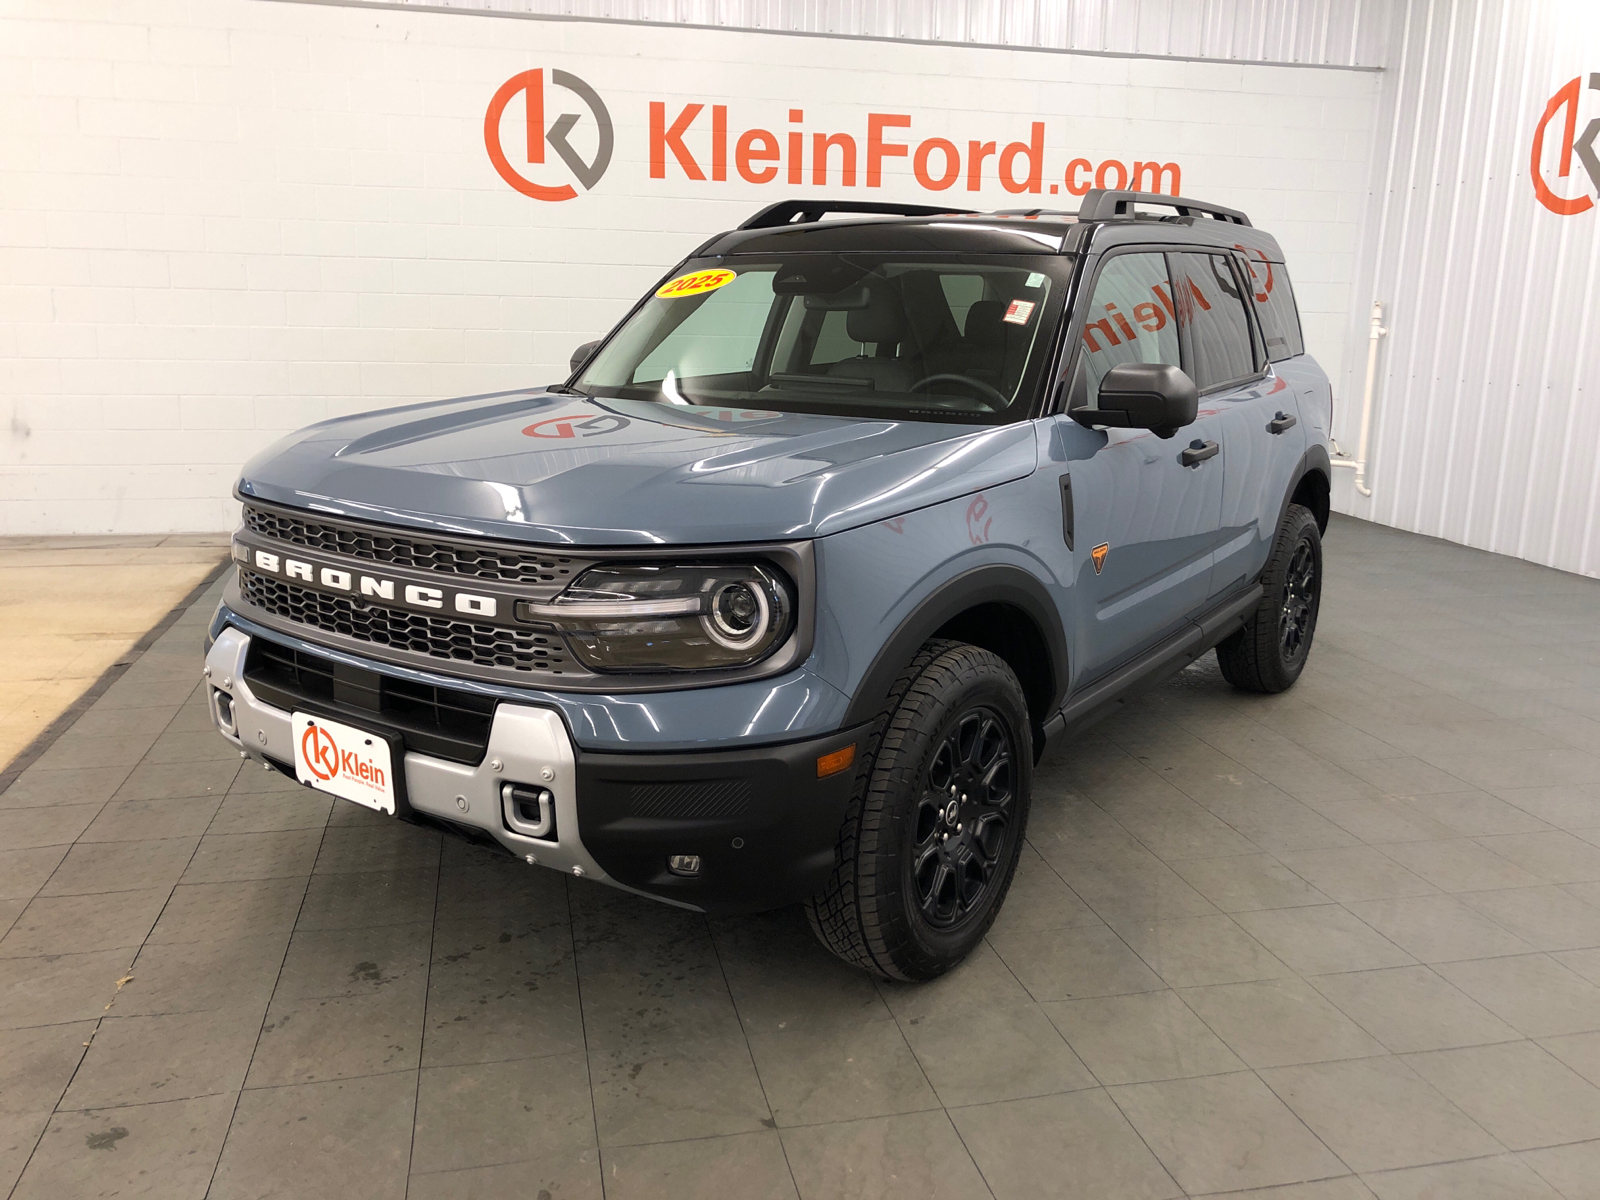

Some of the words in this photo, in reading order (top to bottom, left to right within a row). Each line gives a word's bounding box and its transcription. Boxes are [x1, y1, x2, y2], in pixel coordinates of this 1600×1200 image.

[649, 101, 1181, 197] KleinFord.com
[660, 273, 730, 294] 2025
[255, 550, 497, 617] BRONCO
[341, 749, 385, 787] Klein
